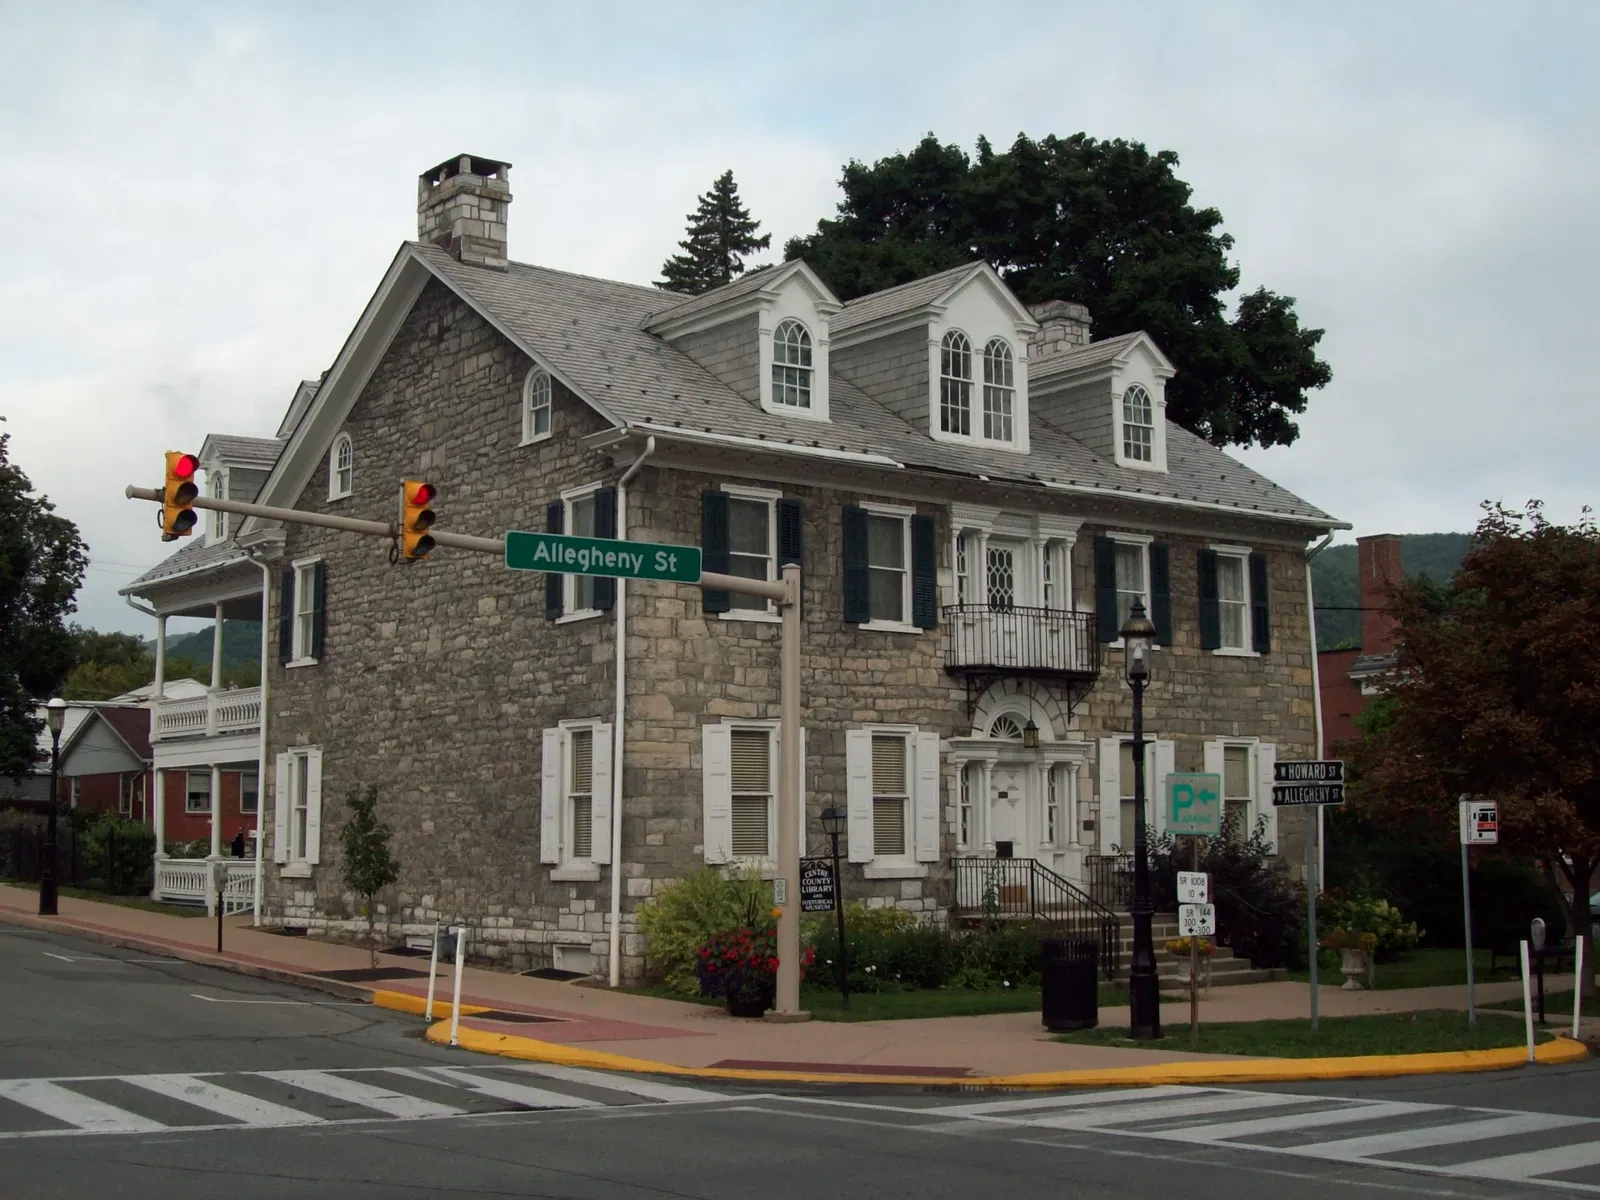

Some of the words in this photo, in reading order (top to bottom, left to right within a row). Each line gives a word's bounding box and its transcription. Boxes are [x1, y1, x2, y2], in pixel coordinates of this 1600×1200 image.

[533, 541, 644, 574] Allegheny
[654, 551, 677, 573] St
[1280, 766, 1286, 777] W
[1288, 764, 1326, 779] HOWARD
[1328, 766, 1336, 776] ST
[1284, 787, 1330, 803] ALLEGHENY
[1332, 788, 1338, 798] ST
[804, 869, 829, 878] CENTRE
[1180, 877, 1187, 885] SR
[802, 885, 832, 893] LIBRARY
[1188, 890, 1194, 898] 10
[1186, 909, 1194, 917] SR
[1184, 918, 1196, 927] 300
